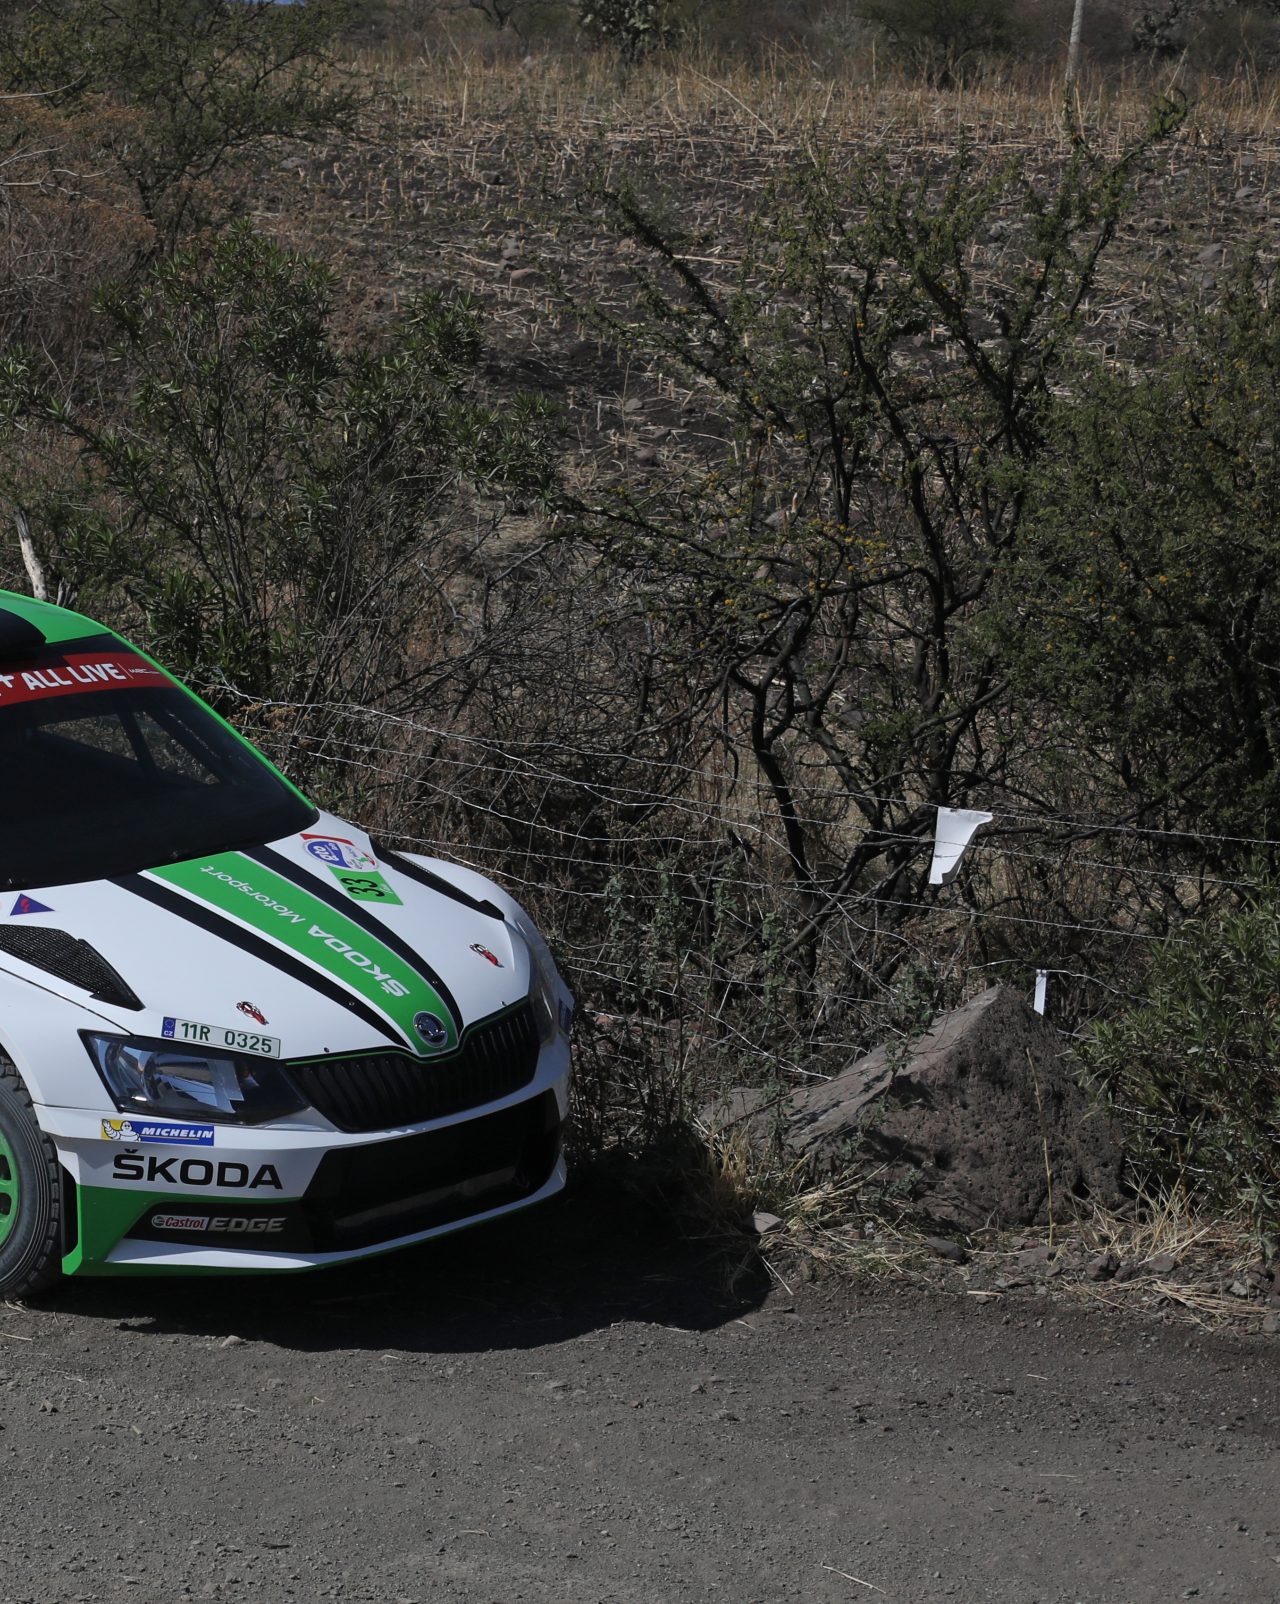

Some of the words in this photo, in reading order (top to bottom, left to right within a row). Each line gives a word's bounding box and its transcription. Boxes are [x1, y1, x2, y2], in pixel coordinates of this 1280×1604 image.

[21, 666, 72, 691] ALL
[67, 662, 126, 684] LIVE
[199, 864, 306, 924] Motorsport
[340, 877, 385, 897] 33
[307, 924, 411, 998] ŠKODA
[224, 1029, 272, 1054] 0325
[141, 1127, 214, 1139] MICHELIN
[112, 1148, 283, 1190] ŠKODA
[164, 1216, 205, 1230] Castrol
[208, 1216, 287, 1233] EDGE
